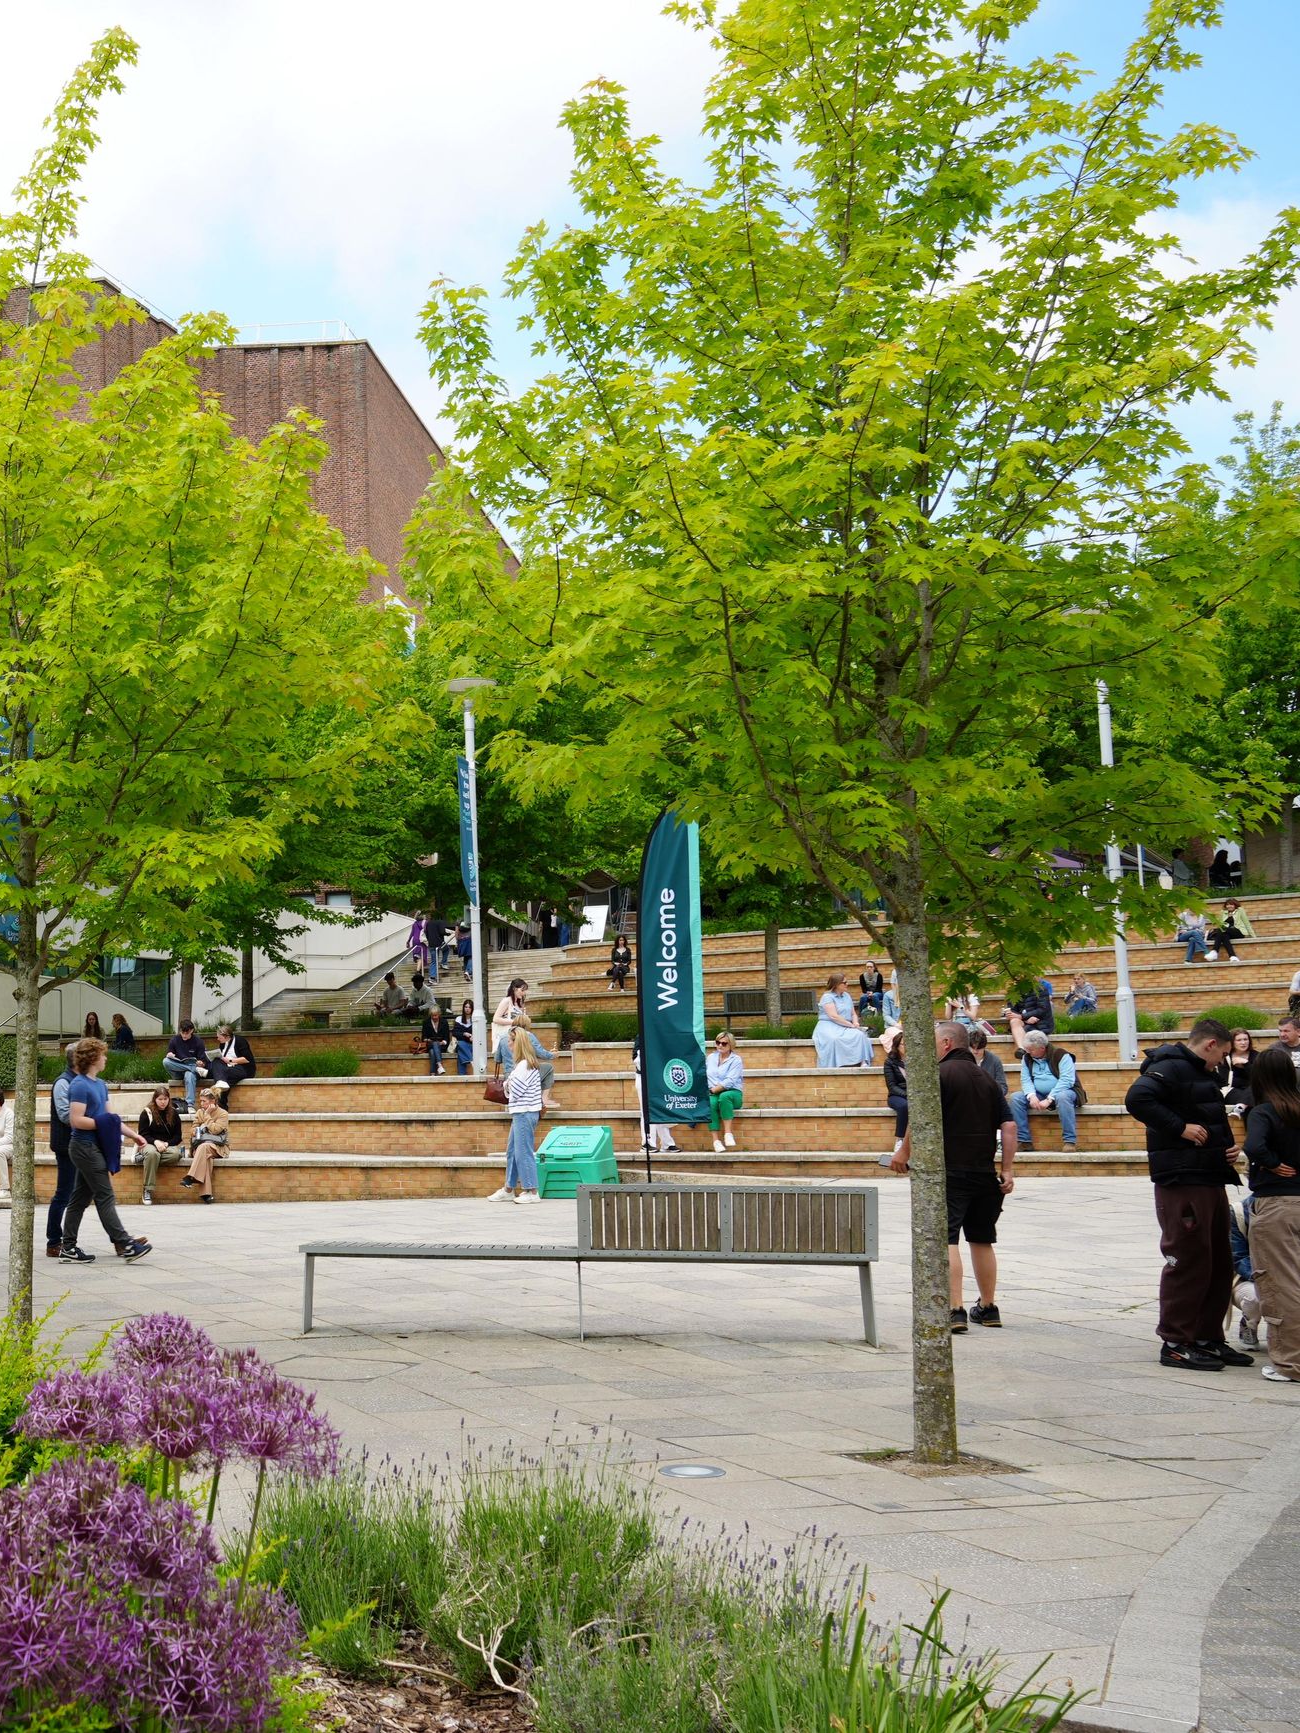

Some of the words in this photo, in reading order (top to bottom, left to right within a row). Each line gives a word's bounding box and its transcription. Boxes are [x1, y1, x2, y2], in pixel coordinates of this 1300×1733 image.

[656, 888, 678, 1011] Welcome
[664, 1094, 698, 1103] University
[665, 1102, 674, 1110] of
[675, 1101, 697, 1109] Exeter
